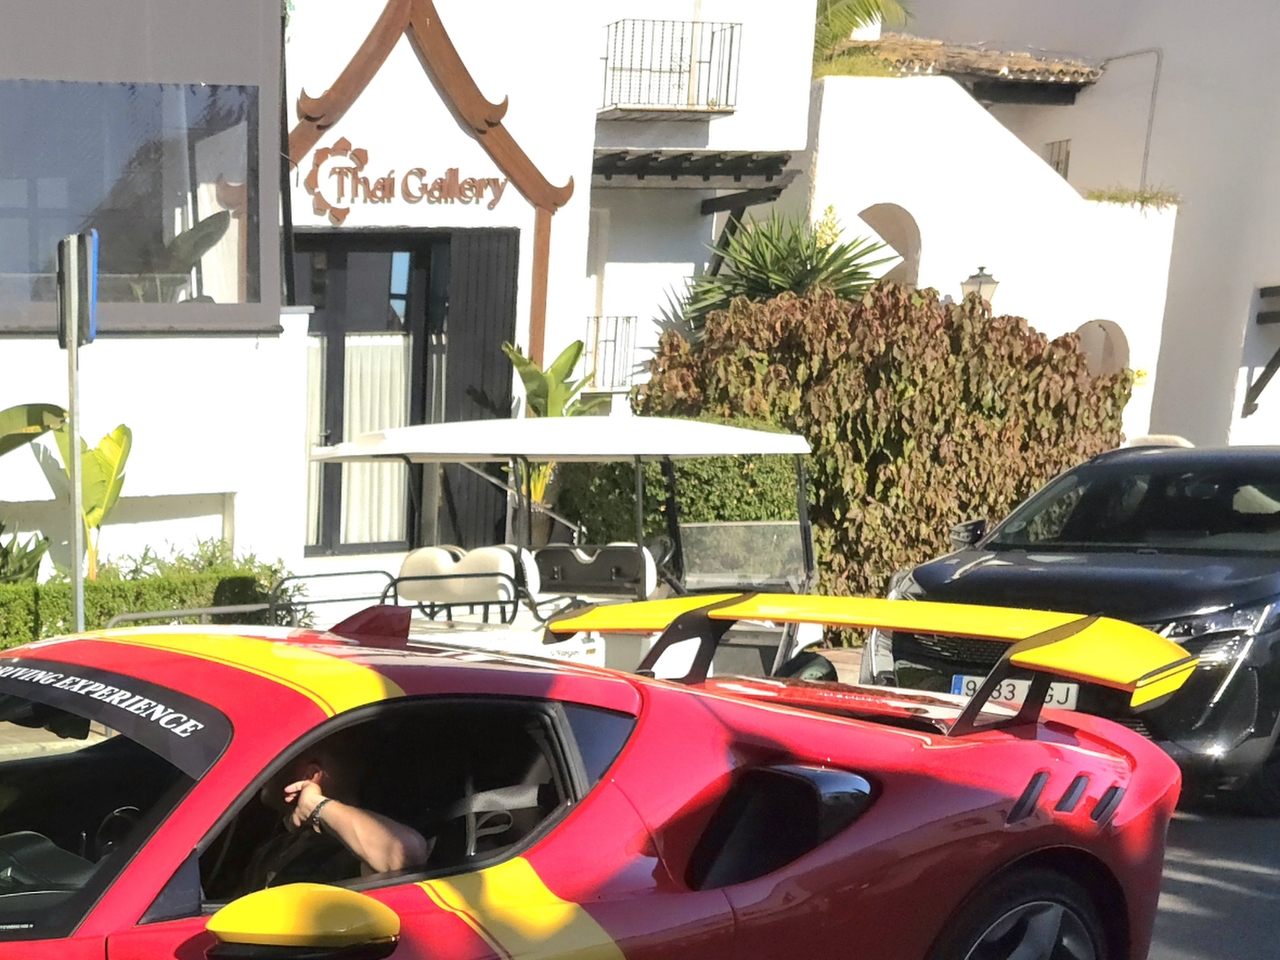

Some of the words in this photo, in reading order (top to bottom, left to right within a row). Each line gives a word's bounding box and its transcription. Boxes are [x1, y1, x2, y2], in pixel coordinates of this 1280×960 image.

[329, 167, 395, 204] Thai
[401, 167, 508, 211] Gallery
[52, 675, 204, 738] EXPERIENCE
[965, 680, 1016, 701] 933
